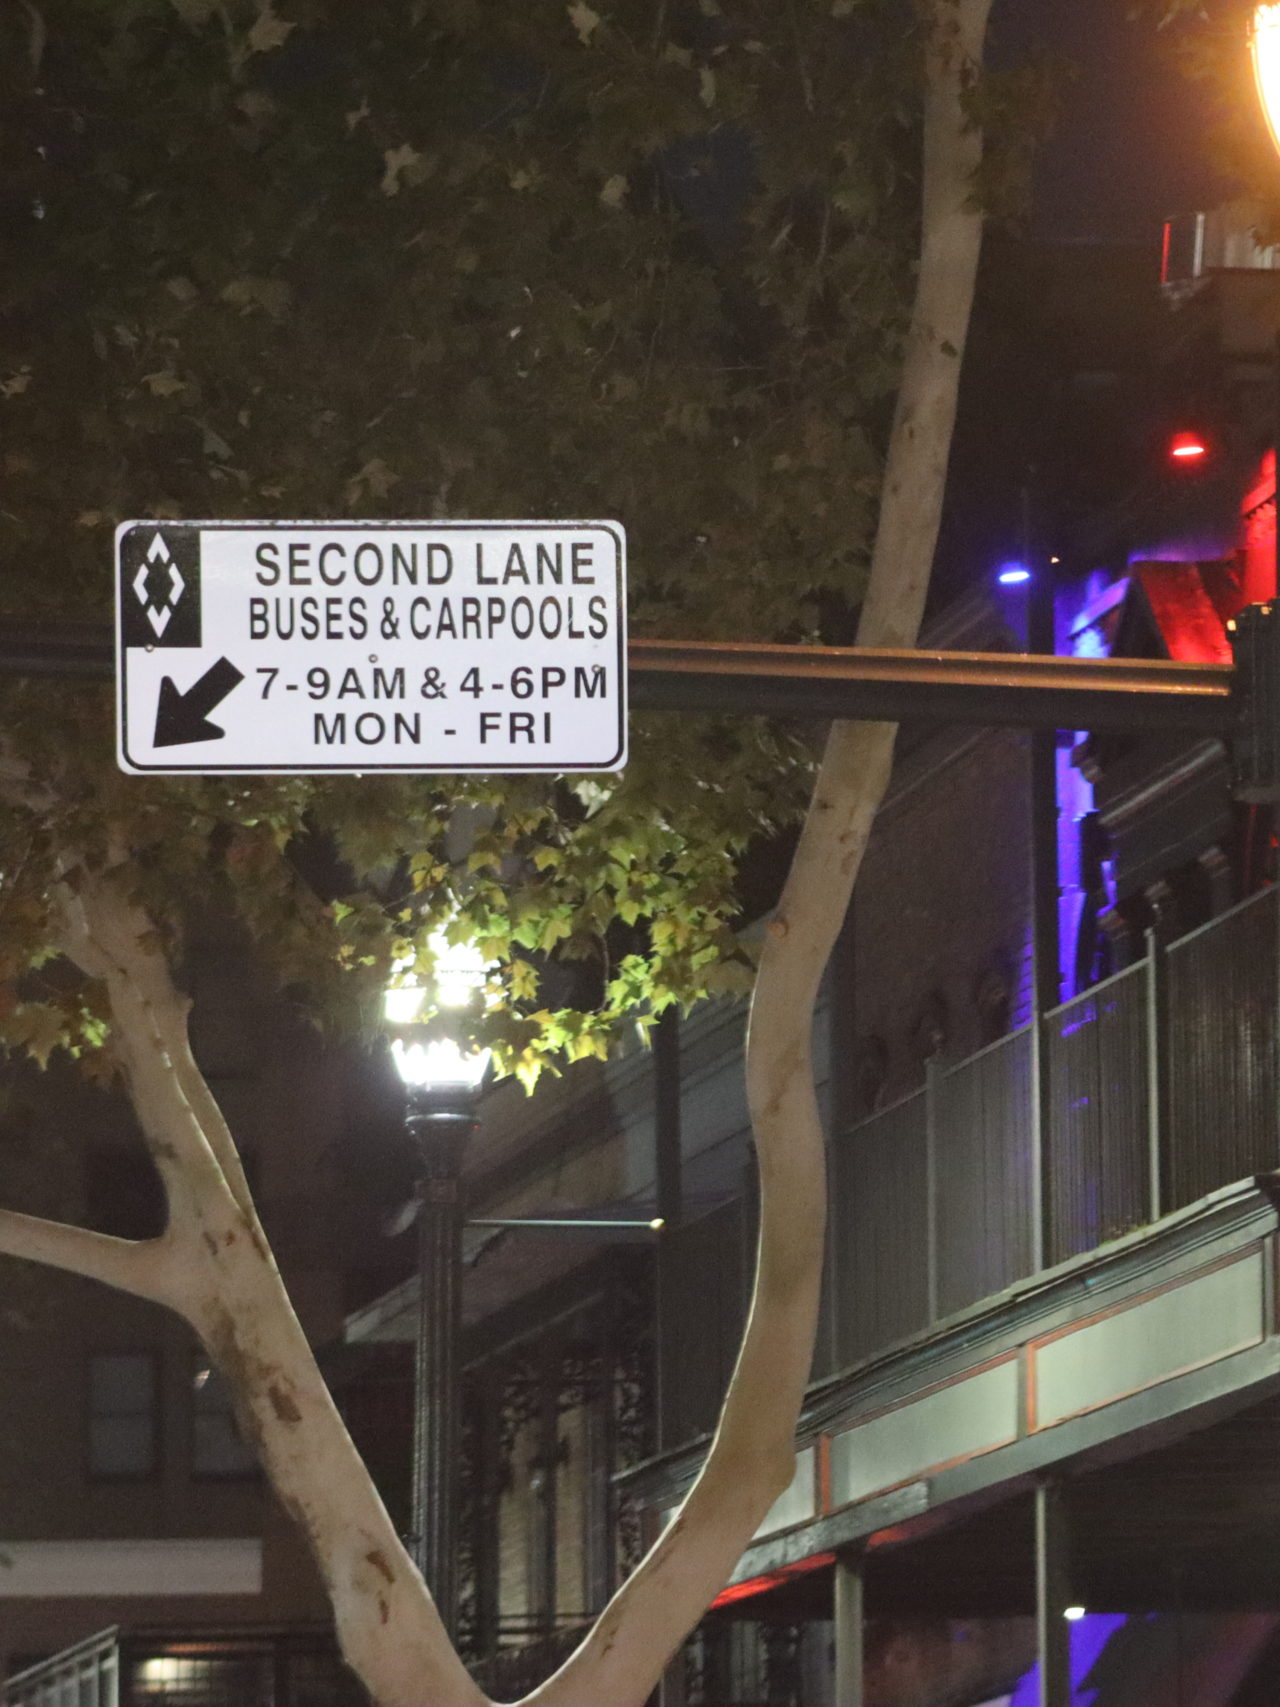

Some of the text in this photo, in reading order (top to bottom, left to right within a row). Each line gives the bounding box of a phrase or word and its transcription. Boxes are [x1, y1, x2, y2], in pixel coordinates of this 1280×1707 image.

[255, 542, 596, 586] SECOND LANE
[249, 596, 608, 641] BUSES & CARPOOLS
[255, 666, 608, 701] 7-9AM & 4-6PM
[313, 713, 422, 746] MON
[479, 712, 552, 745] FRI
